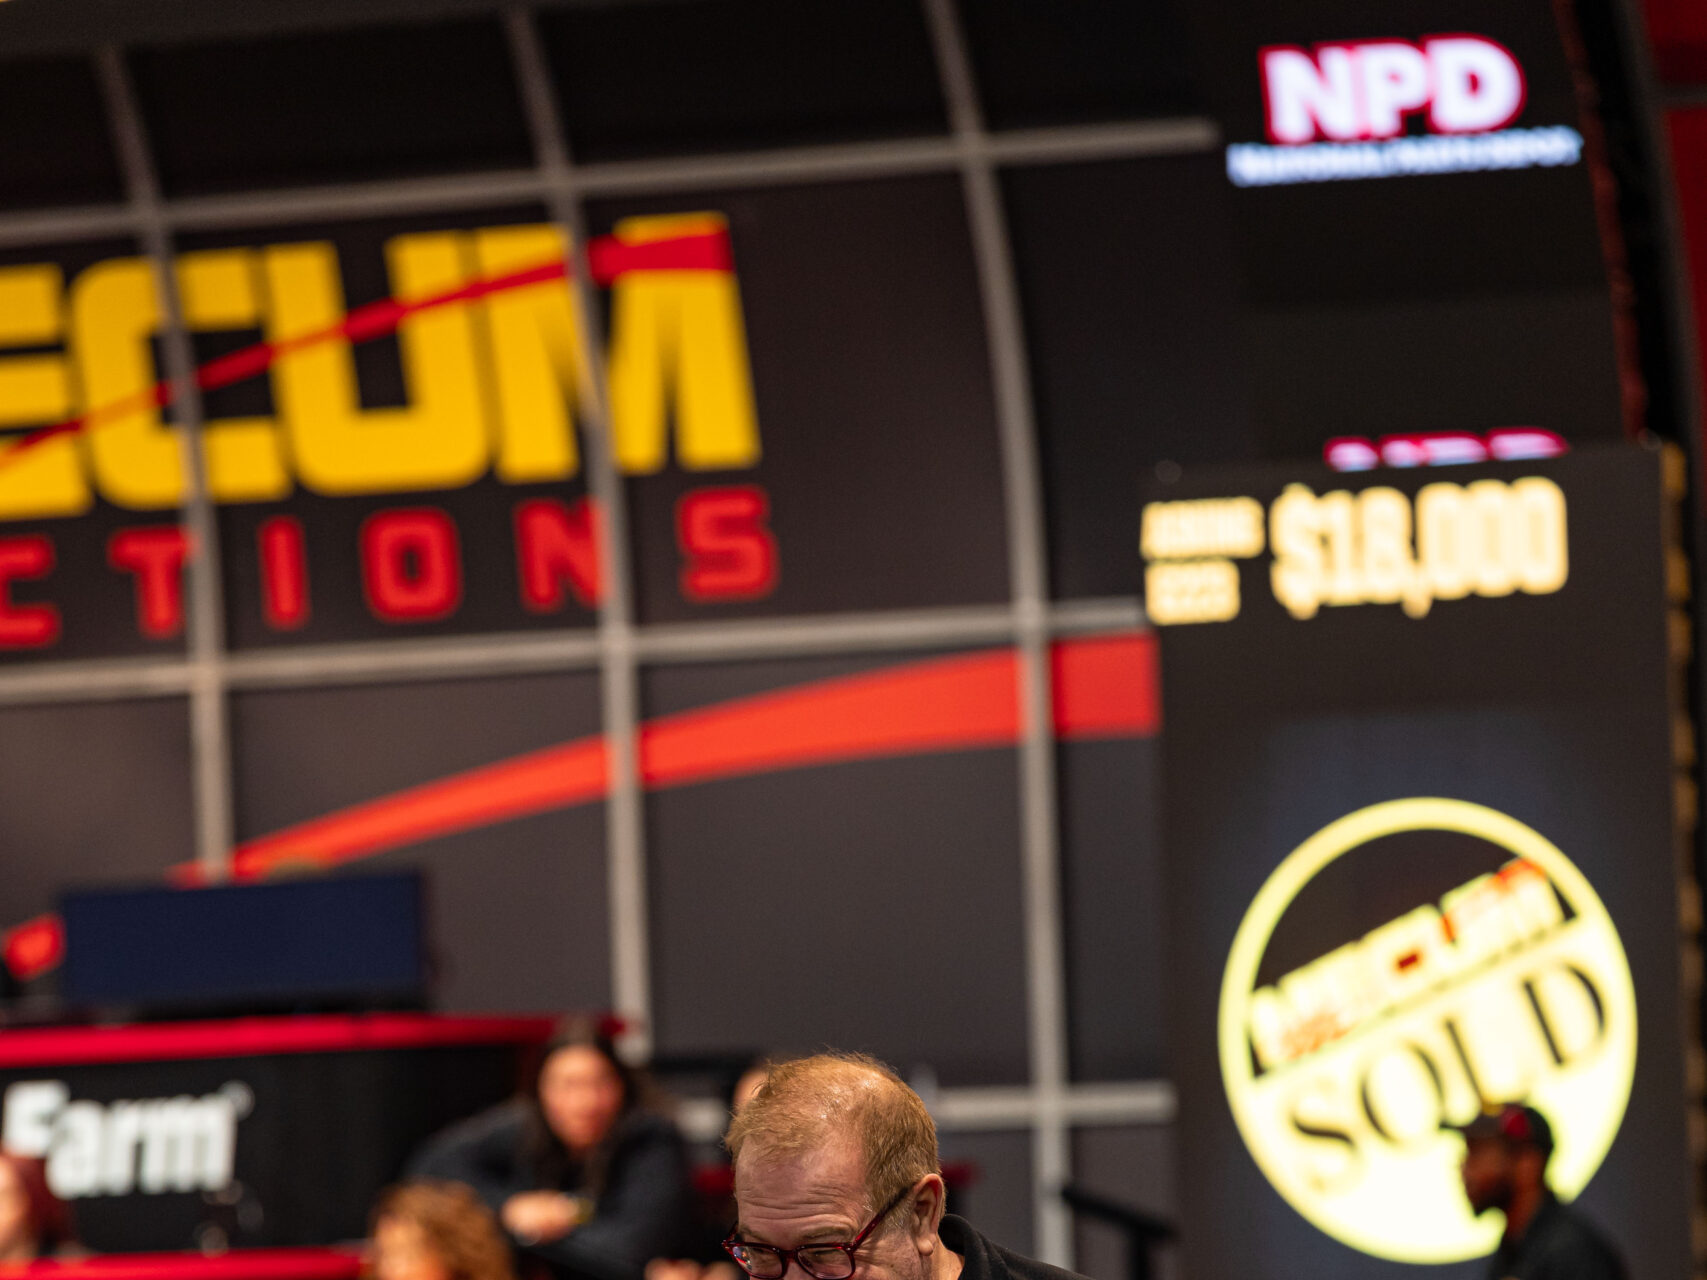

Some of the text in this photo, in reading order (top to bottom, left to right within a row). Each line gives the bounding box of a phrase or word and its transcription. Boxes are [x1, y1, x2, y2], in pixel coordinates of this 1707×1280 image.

[1257, 31, 1527, 146] NPD
[1288, 962, 1606, 1192] SOLD
[3, 1079, 238, 1198] Farm
